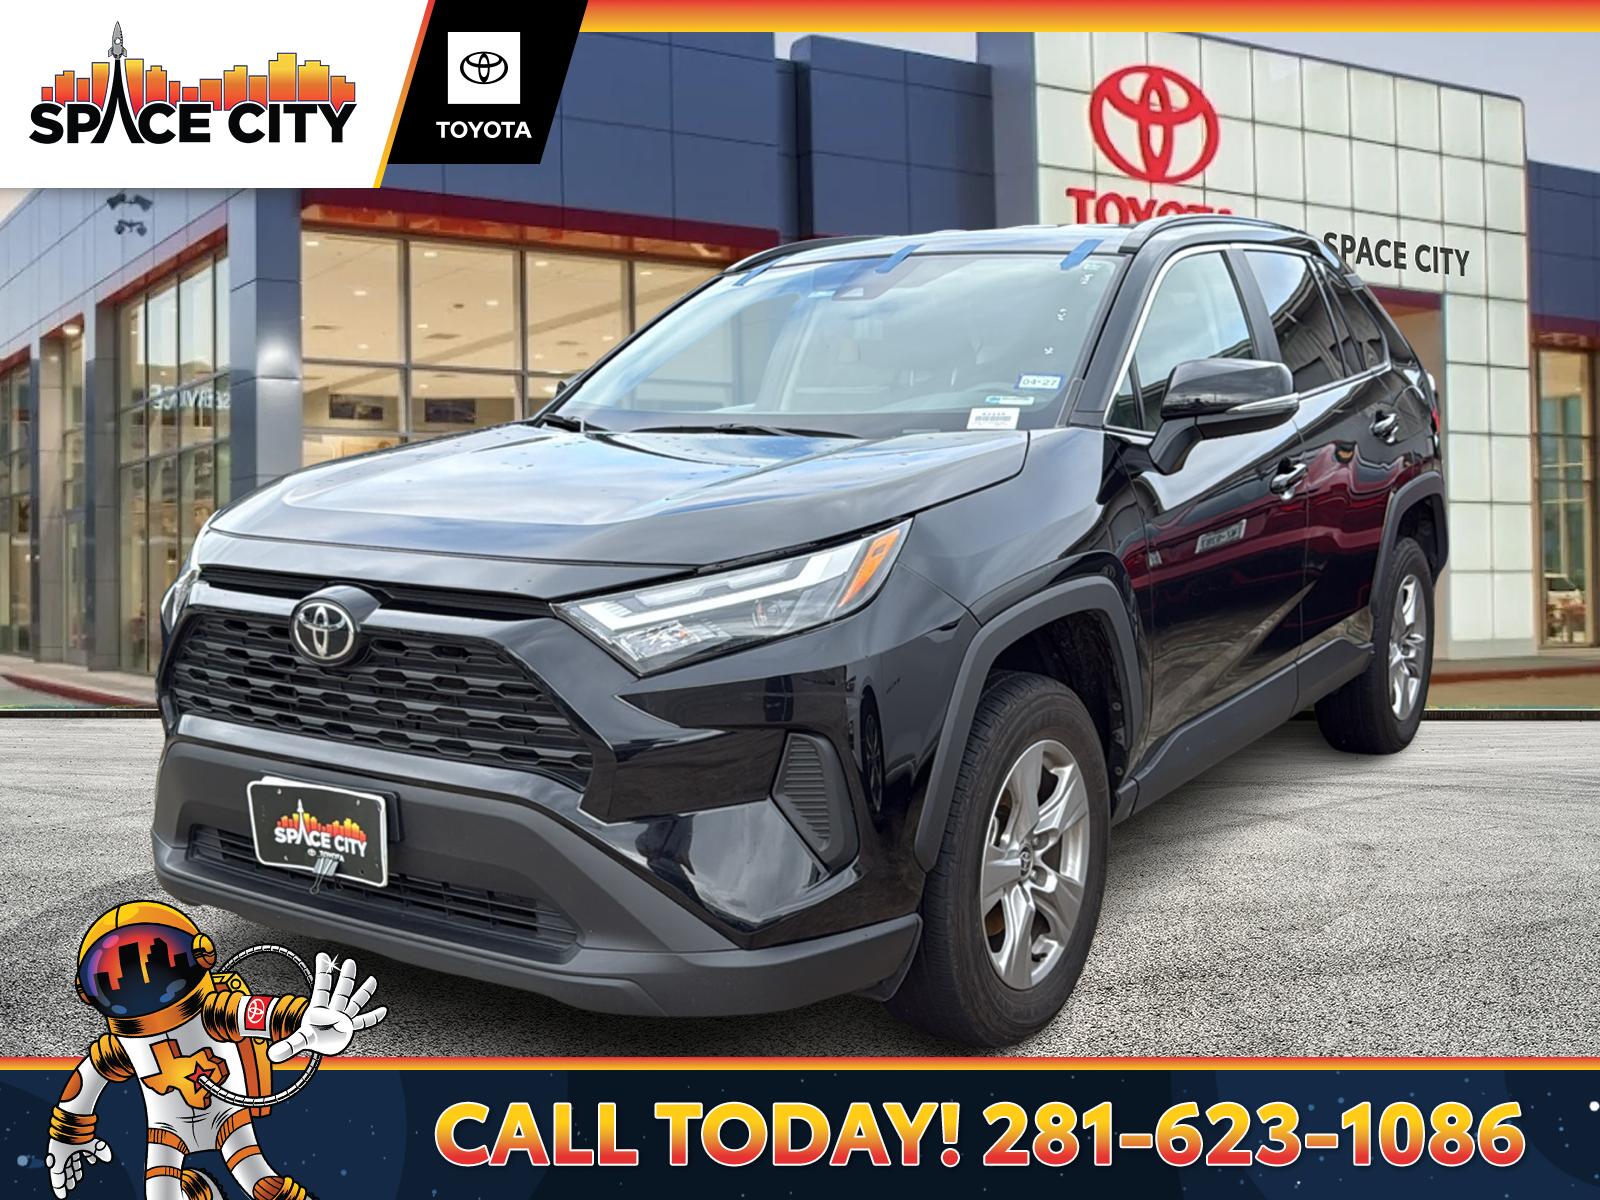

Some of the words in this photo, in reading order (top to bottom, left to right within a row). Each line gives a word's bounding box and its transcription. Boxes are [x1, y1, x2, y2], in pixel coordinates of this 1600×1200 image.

[1066, 187, 1231, 224] TOY
[1323, 232, 1407, 270] SPACE
[1415, 244, 1470, 276] CITY
[274, 811, 331, 849] SPACE
[334, 834, 367, 858] CITY
